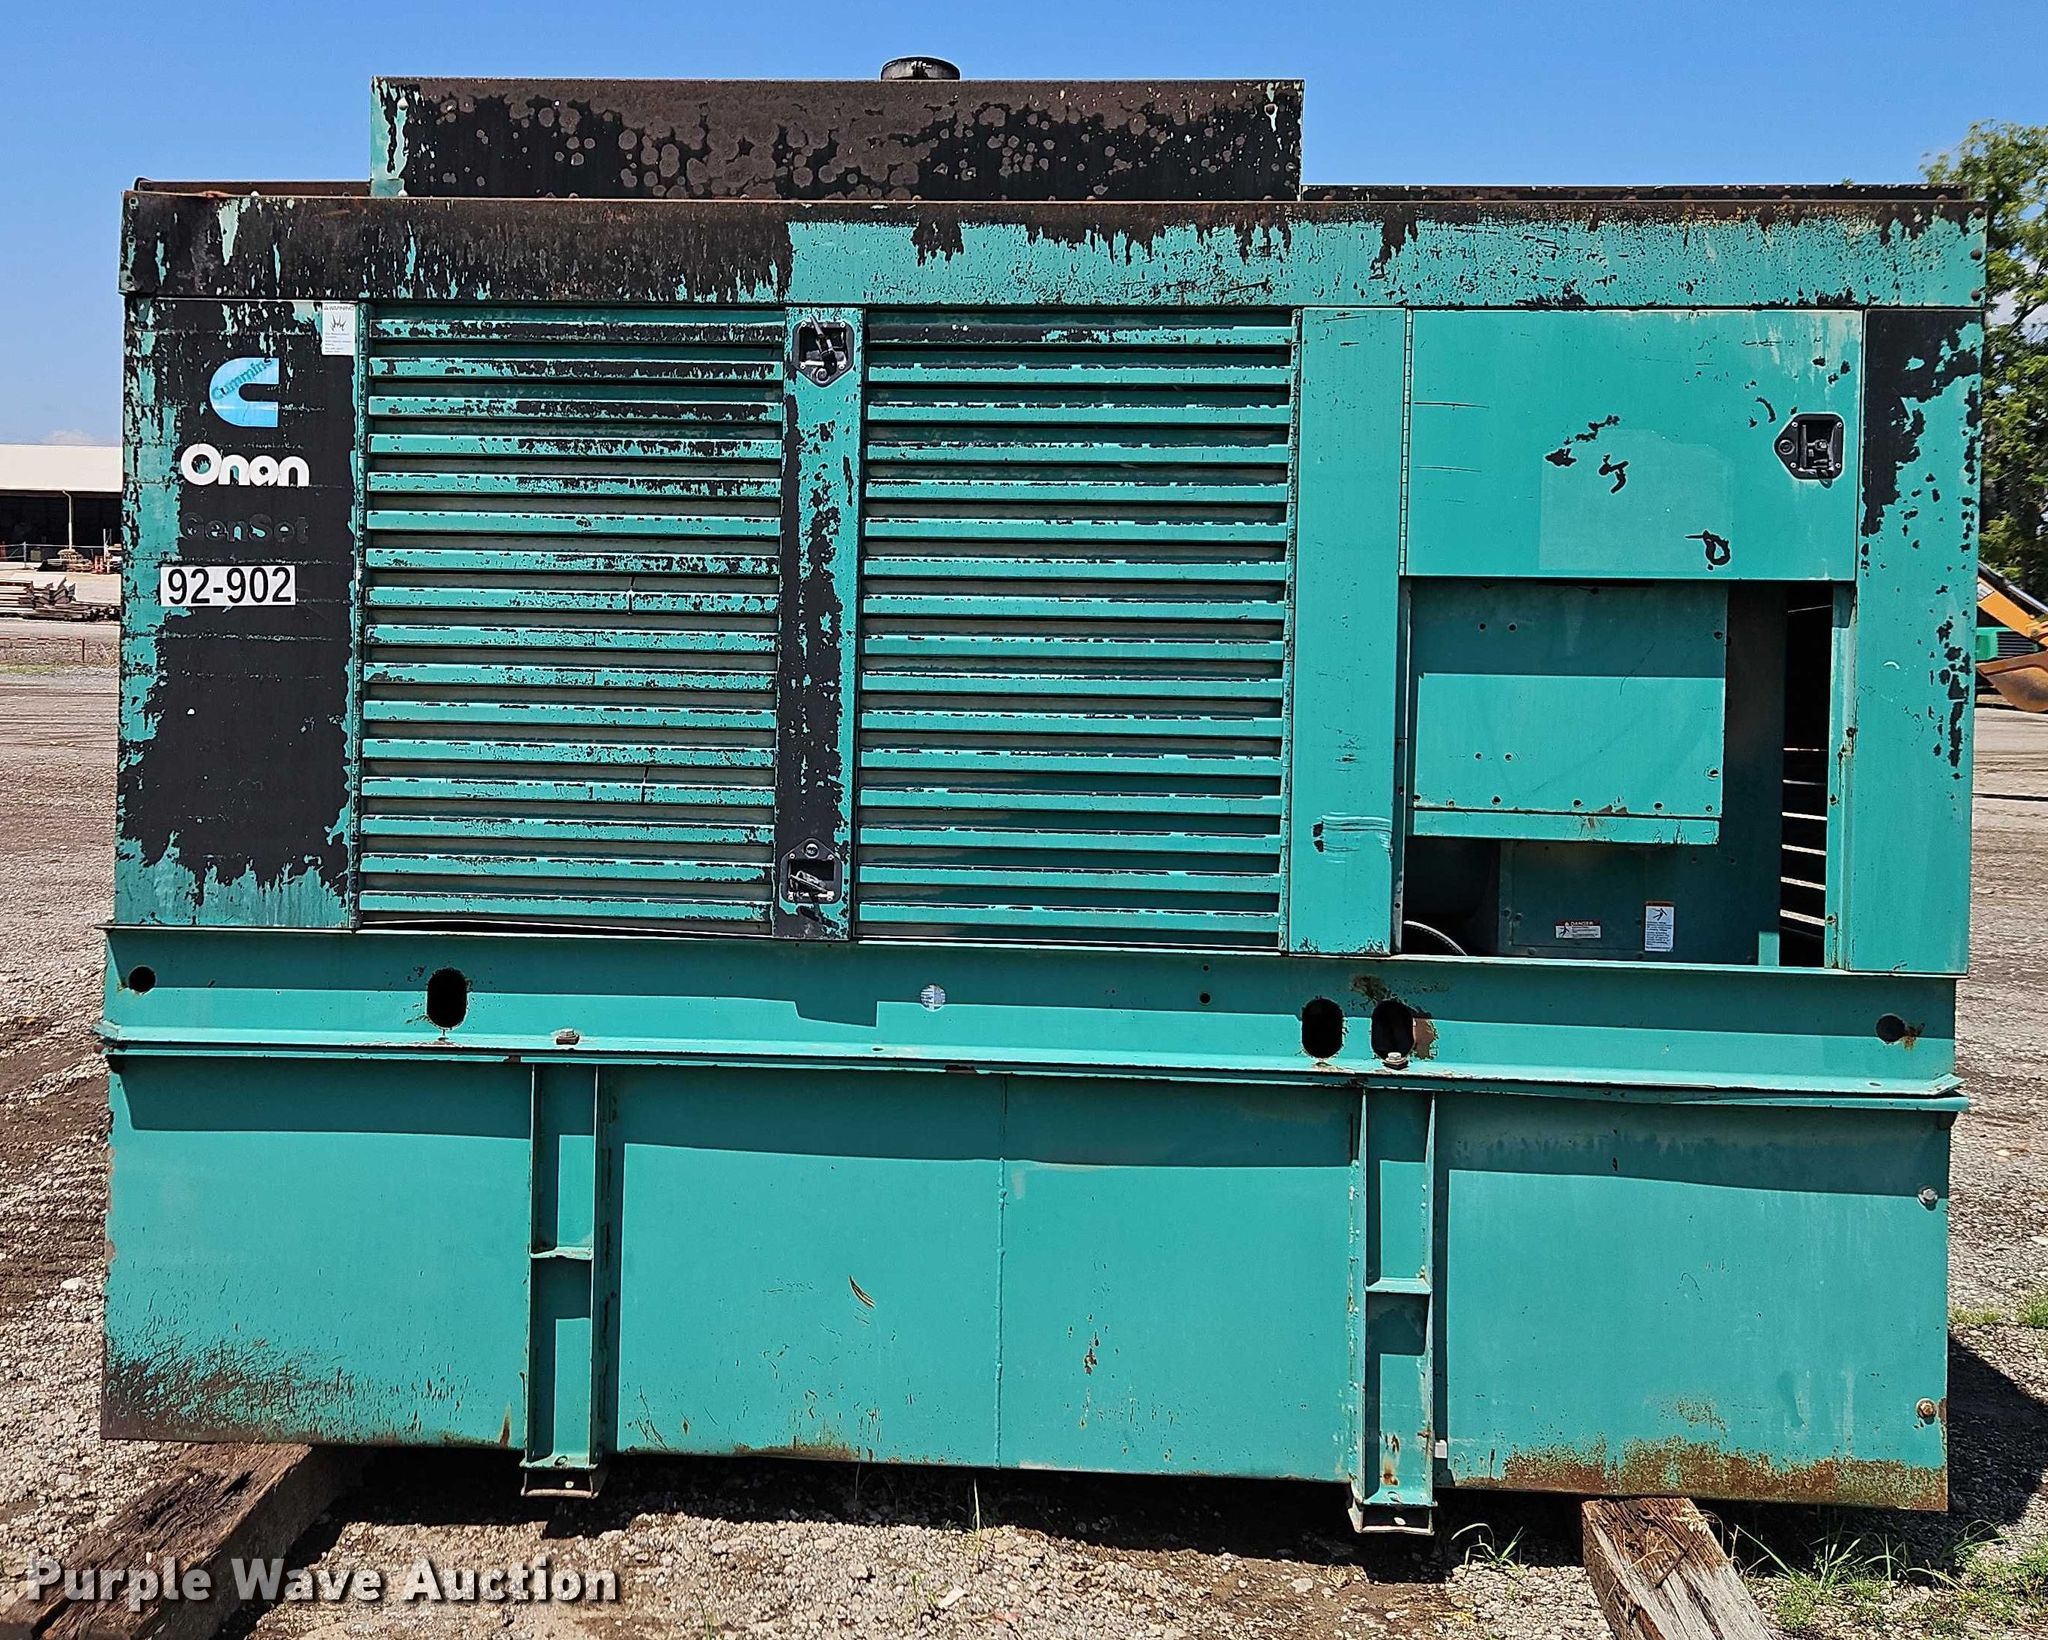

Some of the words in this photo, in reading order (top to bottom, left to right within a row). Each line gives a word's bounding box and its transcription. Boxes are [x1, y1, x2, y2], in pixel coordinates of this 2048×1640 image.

[211, 357, 273, 401] Cummins
[180, 443, 310, 487] Onan
[180, 512, 309, 543] GenSet
[167, 566, 292, 606] 92-902
